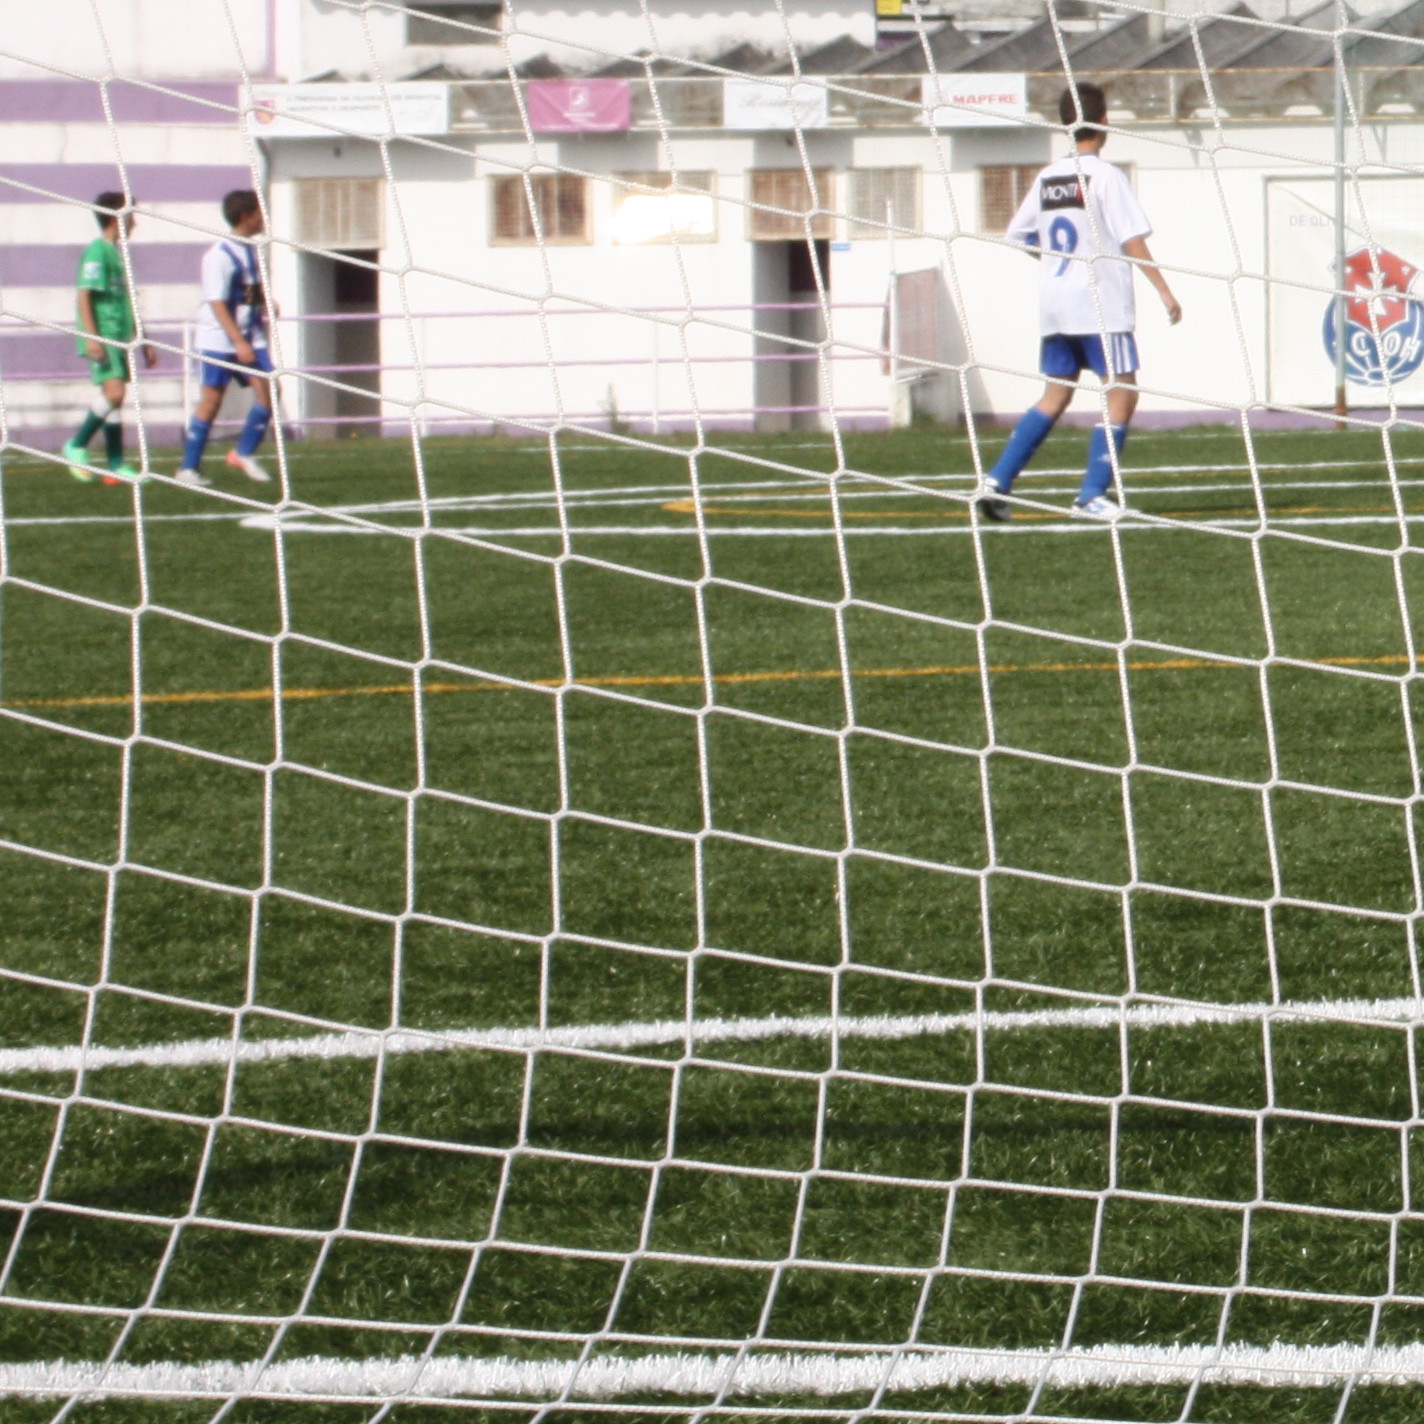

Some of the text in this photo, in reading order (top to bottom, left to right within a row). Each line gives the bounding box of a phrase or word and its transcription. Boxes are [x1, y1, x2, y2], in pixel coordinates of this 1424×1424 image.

[952, 94, 1018, 105] MAPFRE
[1049, 216, 1078, 277] 9
[1332, 330, 1421, 362] COH
